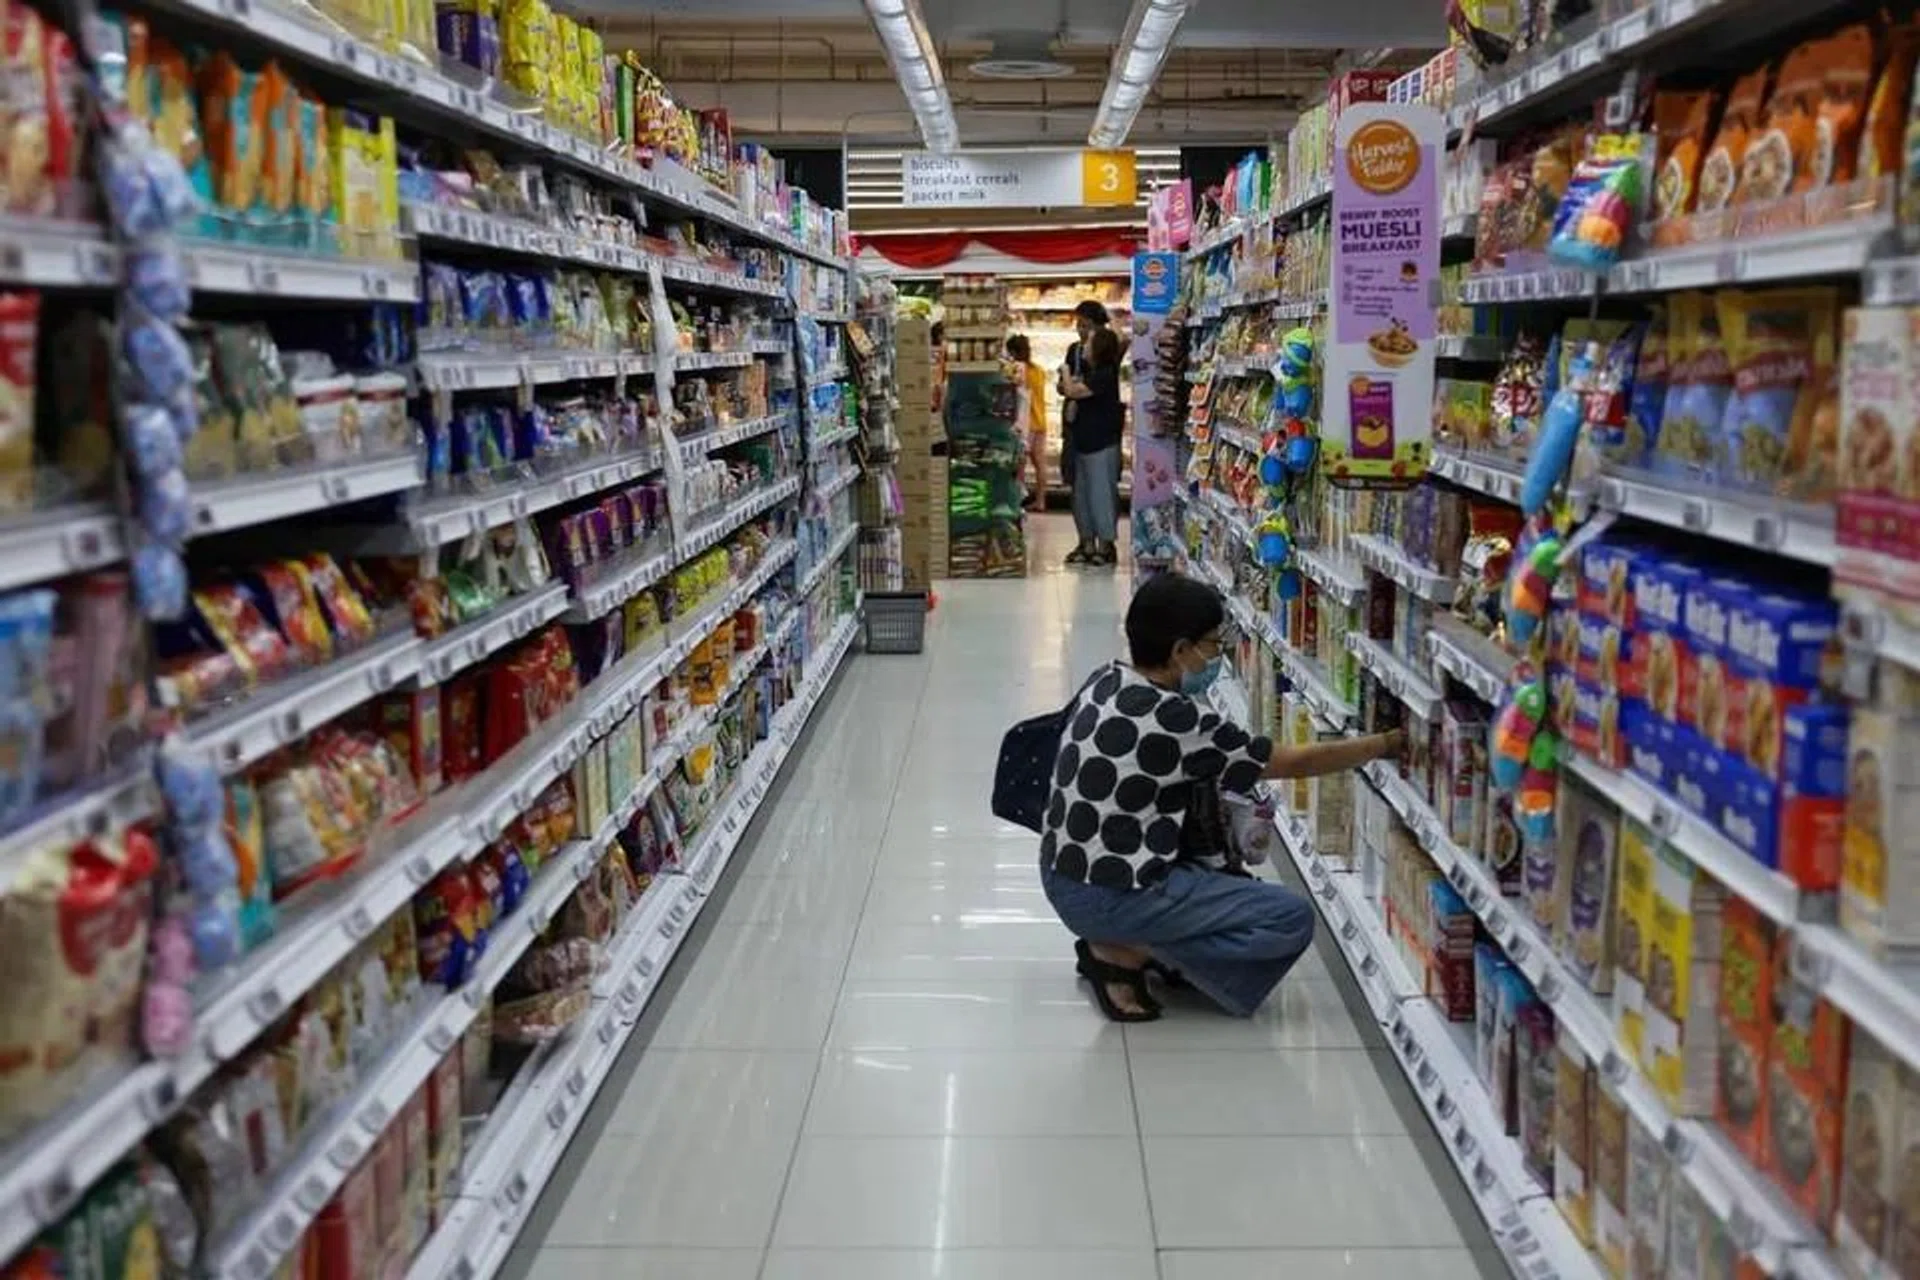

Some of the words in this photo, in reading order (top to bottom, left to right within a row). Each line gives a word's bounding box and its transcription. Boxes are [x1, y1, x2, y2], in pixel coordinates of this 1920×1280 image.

[911, 157, 960, 171] biscuits
[911, 172, 970, 186] breakfast
[975, 172, 1020, 186] cereals
[1100, 162, 1119, 192] 3
[911, 189, 953, 203] packet
[958, 188, 986, 201] milk
[1340, 210, 1377, 221] BERRY
[1382, 207, 1420, 220] BOOST
[1341, 220, 1421, 241] MUESLI
[1342, 239, 1421, 254] BREAKFAST
